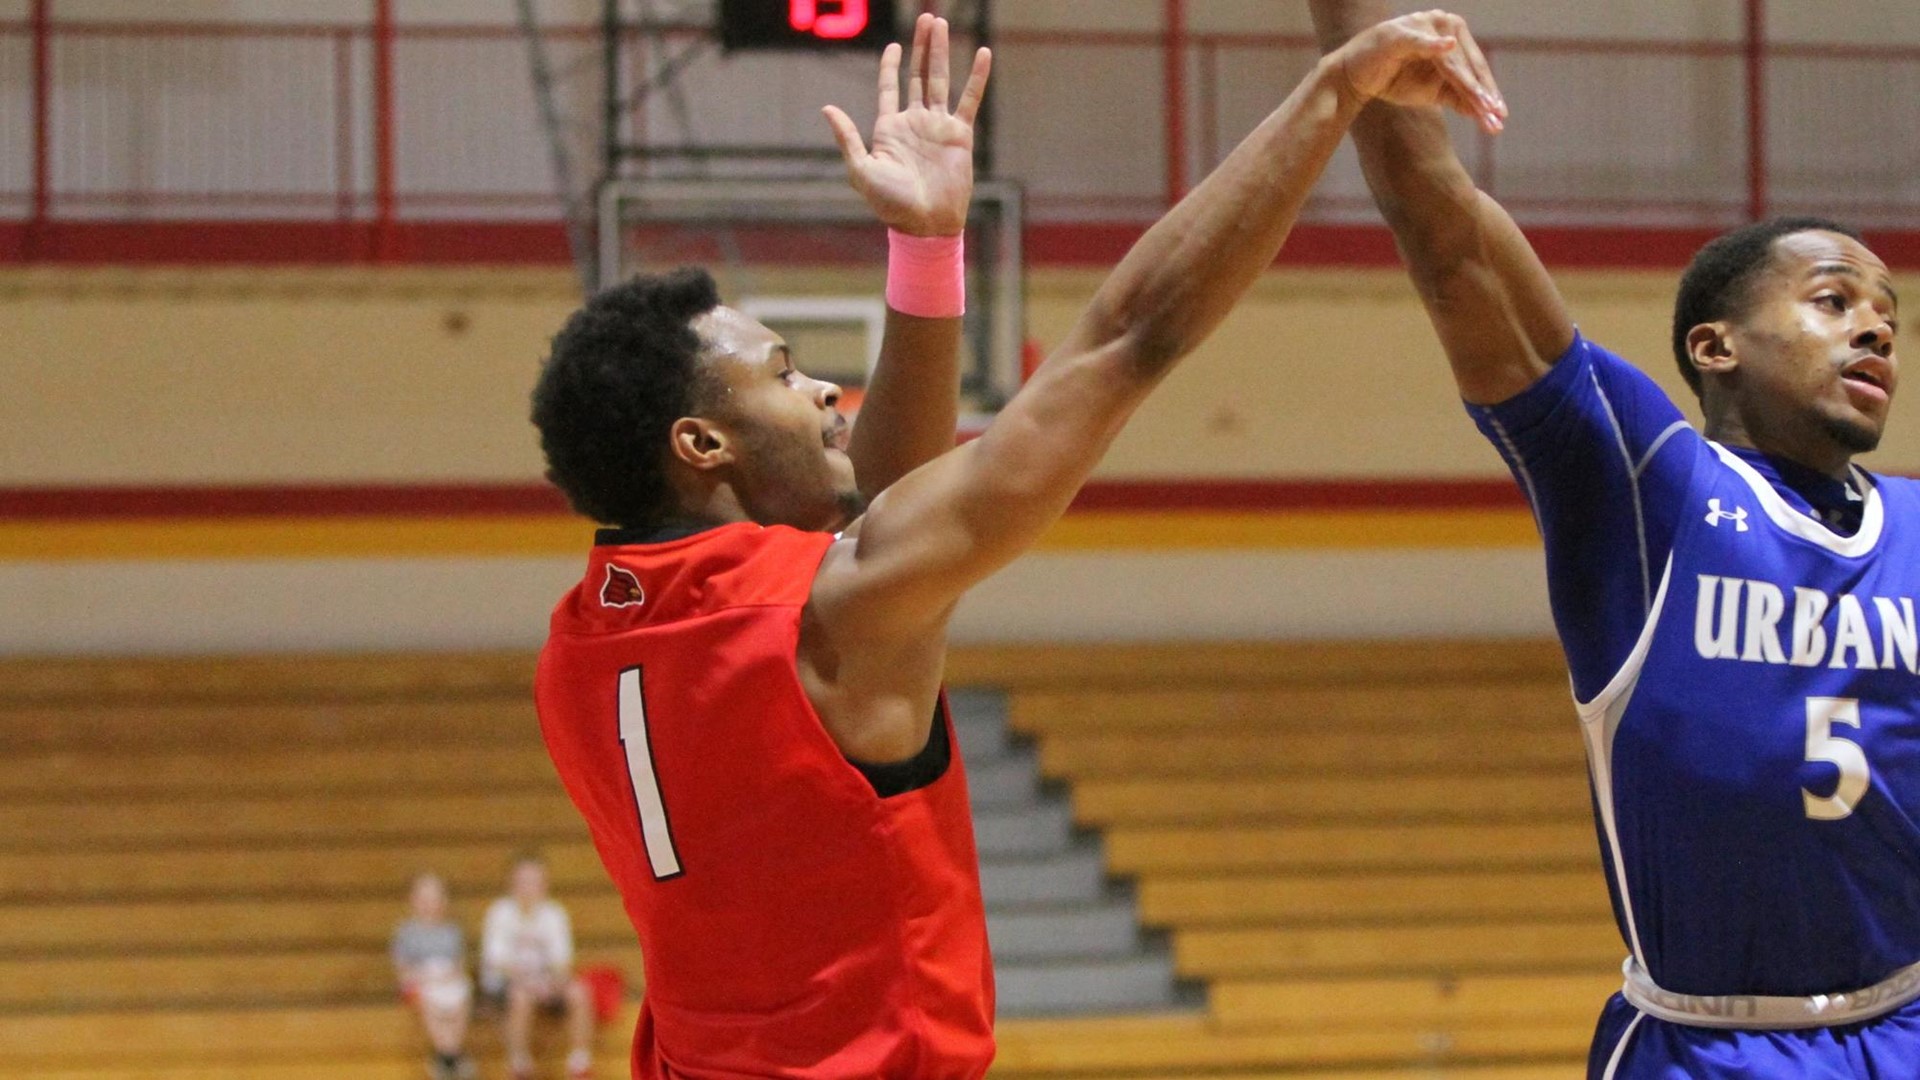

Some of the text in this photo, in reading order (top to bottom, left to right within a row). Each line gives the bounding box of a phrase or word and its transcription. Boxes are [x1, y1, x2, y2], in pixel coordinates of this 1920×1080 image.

[1694, 573, 1920, 676] URBAN
[617, 663, 687, 882] 1
[1801, 696, 1870, 821] 5
